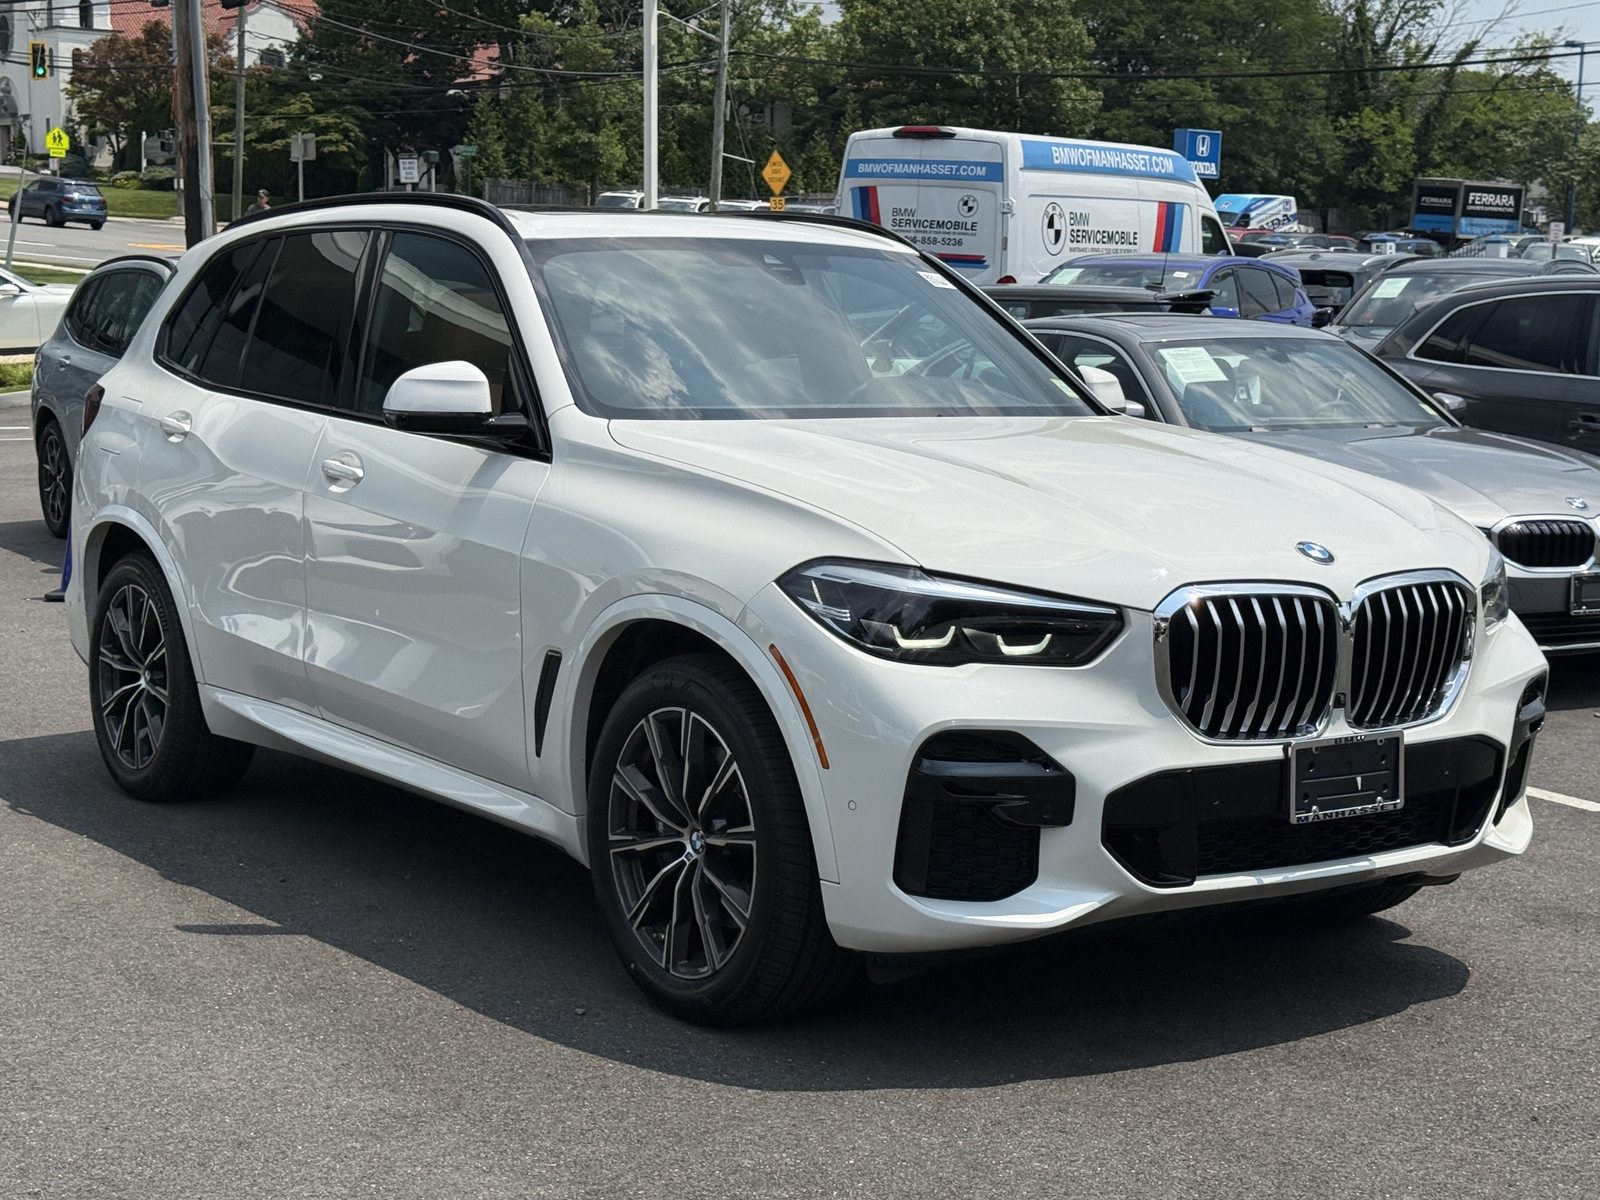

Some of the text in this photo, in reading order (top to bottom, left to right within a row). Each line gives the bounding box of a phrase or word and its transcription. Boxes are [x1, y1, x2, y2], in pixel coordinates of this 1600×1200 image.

[1051, 146, 1174, 174] BMWOFMANHASSET.COM
[858, 163, 986, 176] BMWOFMANHASSET.COM
[772, 199, 784, 210] 35
[1421, 196, 1453, 204] FERRARA
[1469, 192, 1514, 206] FERRARA
[892, 208, 916, 217] BMW
[891, 218, 978, 231] SERVICEMOBILE
[1069, 212, 1090, 227] BMW
[1069, 229, 1138, 246] SERVICEMOBILE
[1335, 735, 1366, 744] BMW
[1296, 803, 1399, 823] MANHASSET
